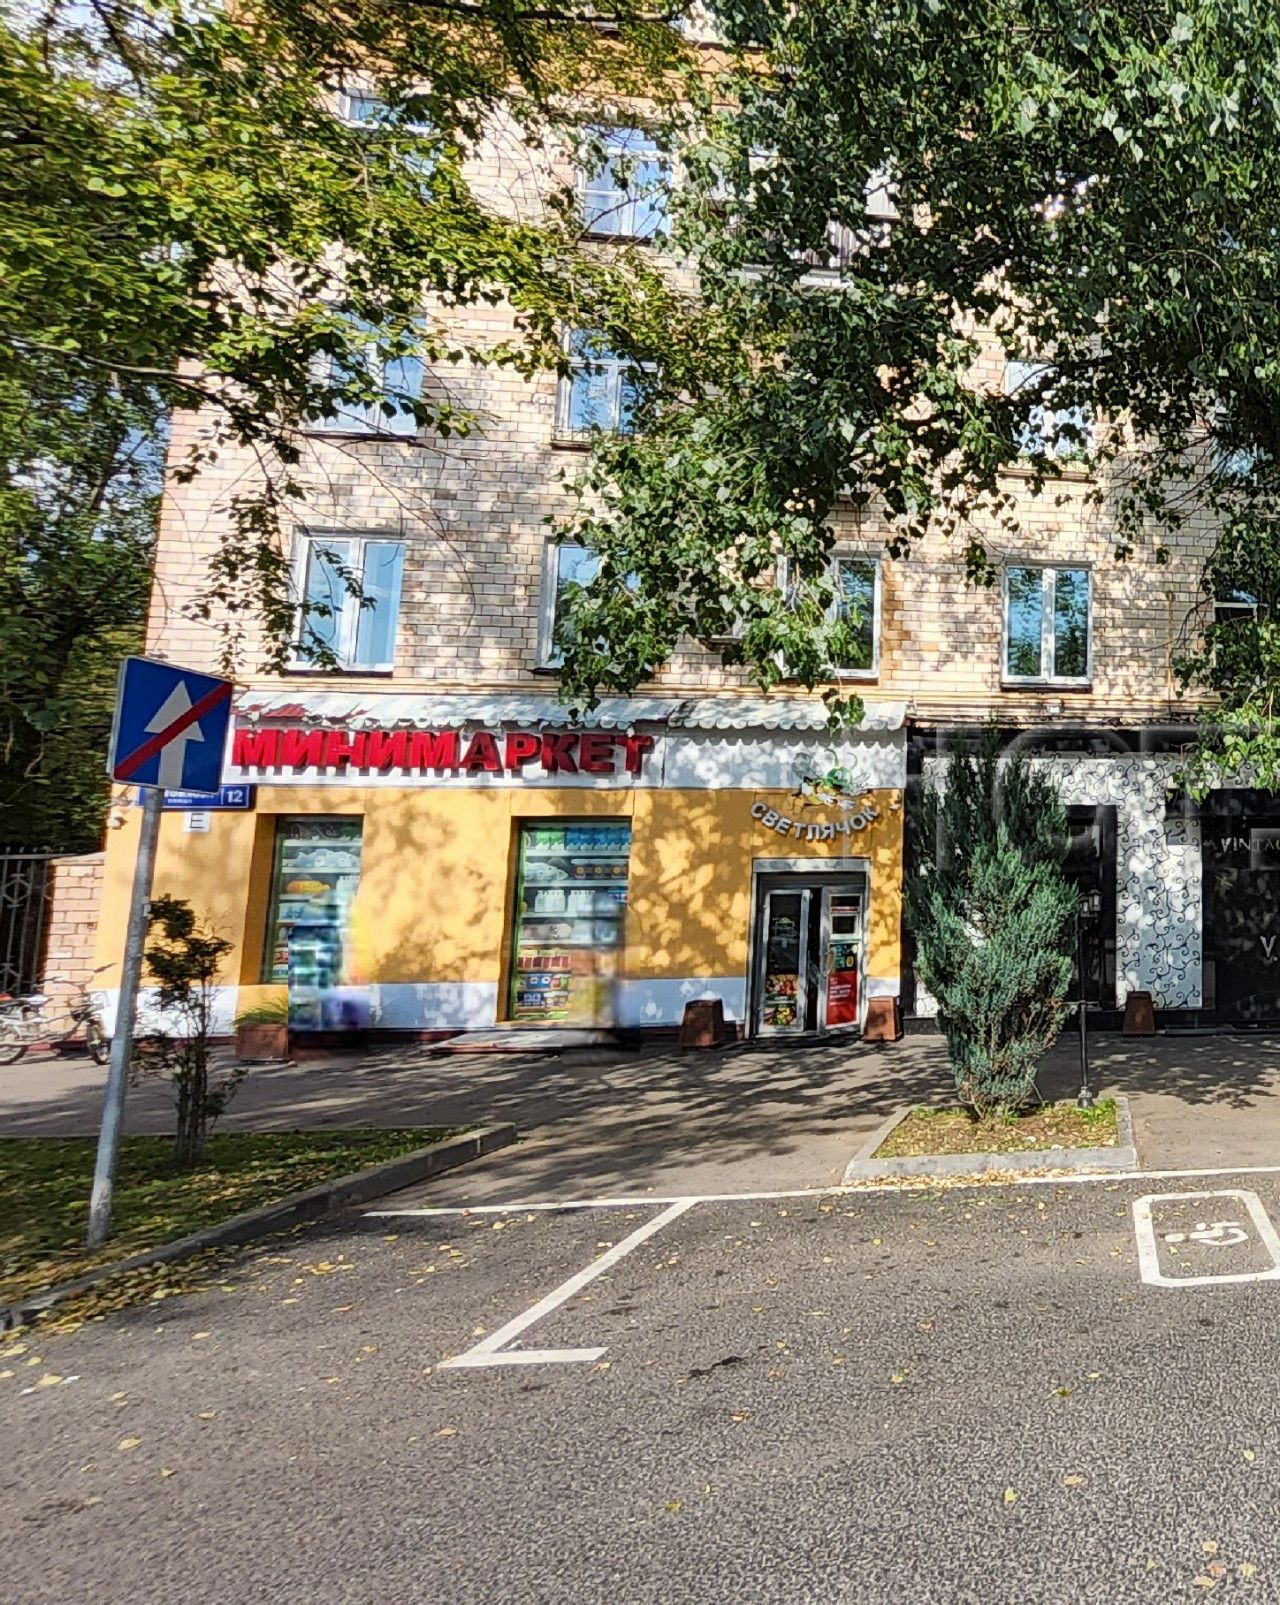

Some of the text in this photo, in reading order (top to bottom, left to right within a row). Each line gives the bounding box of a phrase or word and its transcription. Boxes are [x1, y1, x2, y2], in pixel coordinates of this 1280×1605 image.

[231, 728, 655, 776] МИНИМАРКЕТ
[226, 789, 244, 803] 12
[750, 801, 880, 841] СВЕТЛЯЧОК
